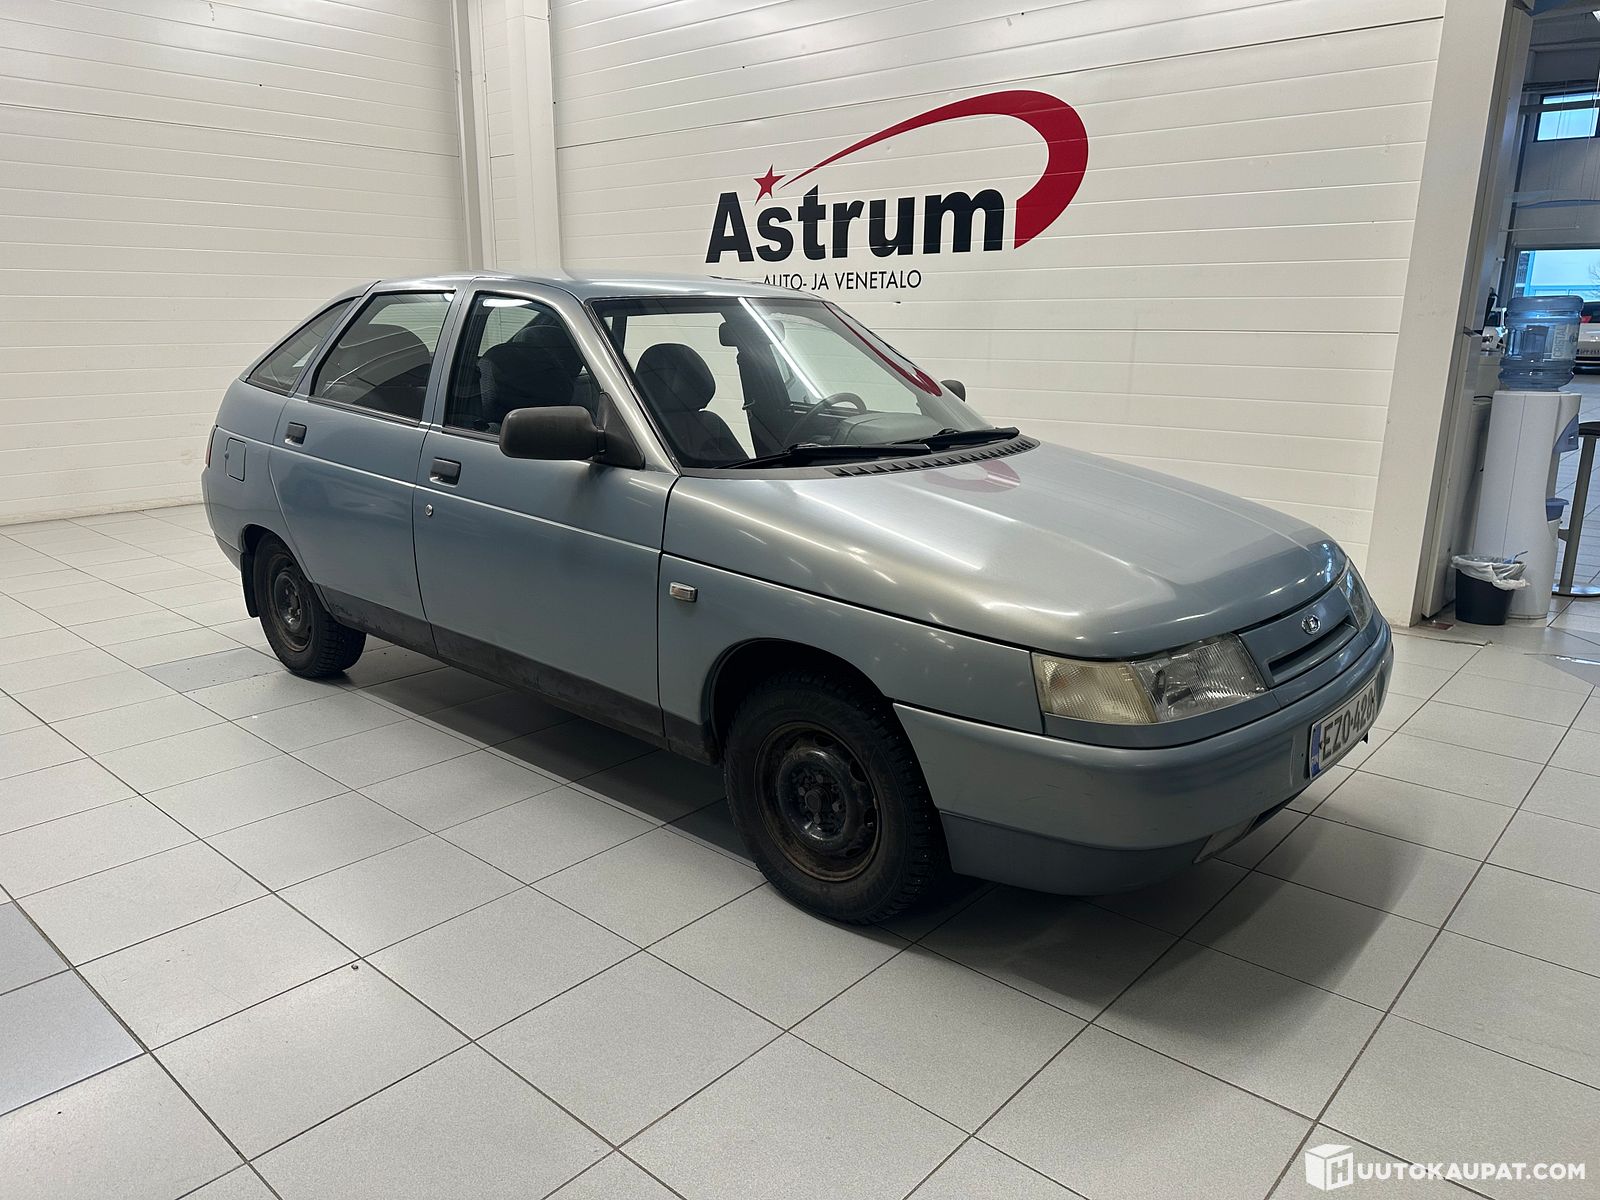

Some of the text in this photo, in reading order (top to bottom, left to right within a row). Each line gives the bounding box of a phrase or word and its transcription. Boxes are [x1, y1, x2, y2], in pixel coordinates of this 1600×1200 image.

[705, 184, 1005, 263] Astrum
[763, 269, 922, 290] AUTO- JA VENETALO
